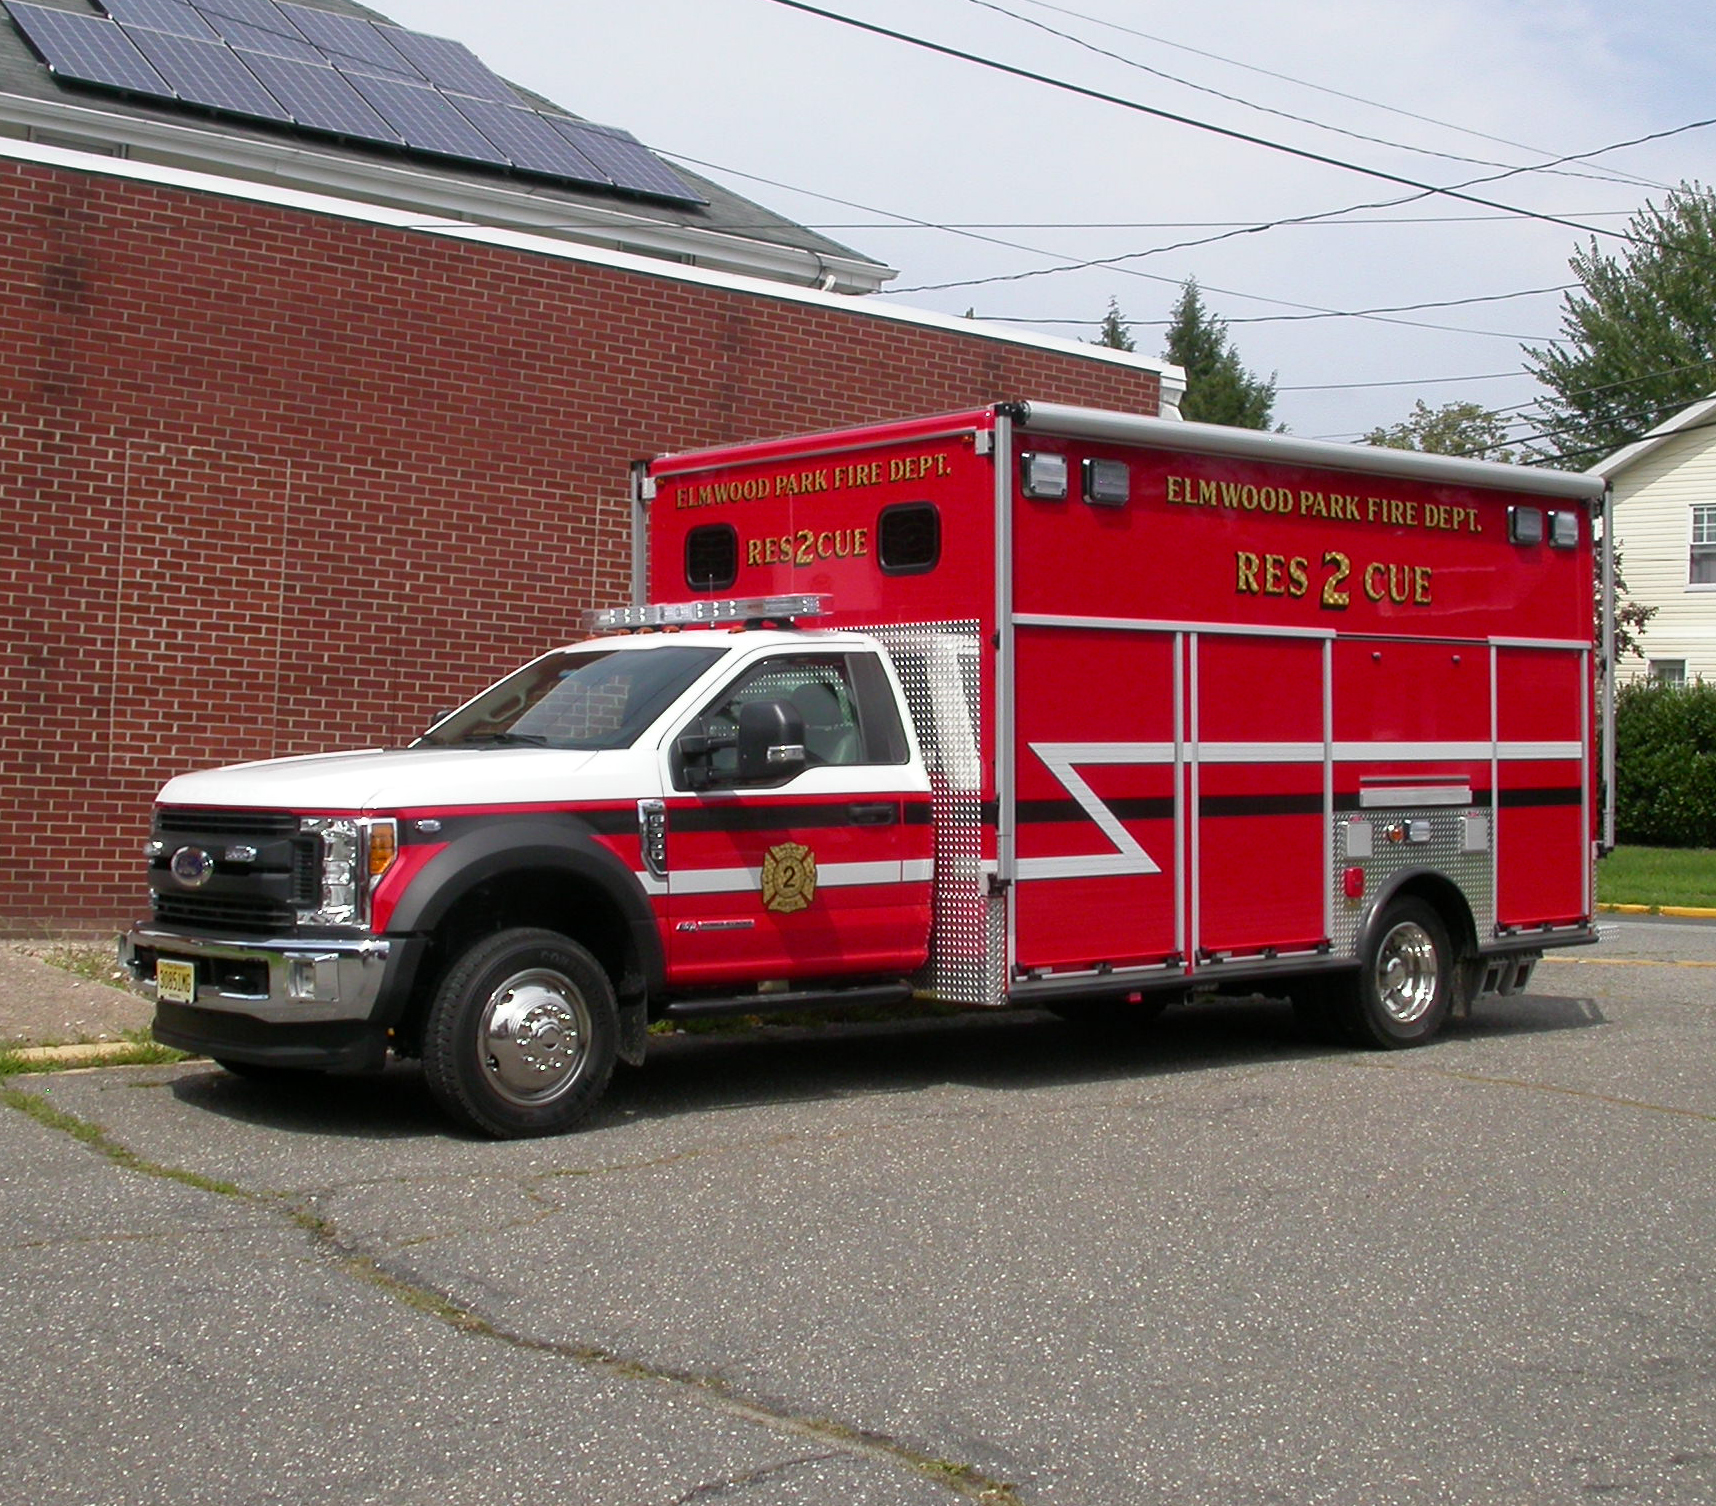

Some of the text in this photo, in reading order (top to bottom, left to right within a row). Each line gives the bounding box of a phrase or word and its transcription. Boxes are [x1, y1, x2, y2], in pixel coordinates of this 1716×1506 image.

[676, 453, 951, 509] ELMWOOD PARK FIRE DEPT.
[1166, 476, 1483, 532] ELMWOOD PARK FIRE DEPT.
[783, 866, 796, 888] 2
